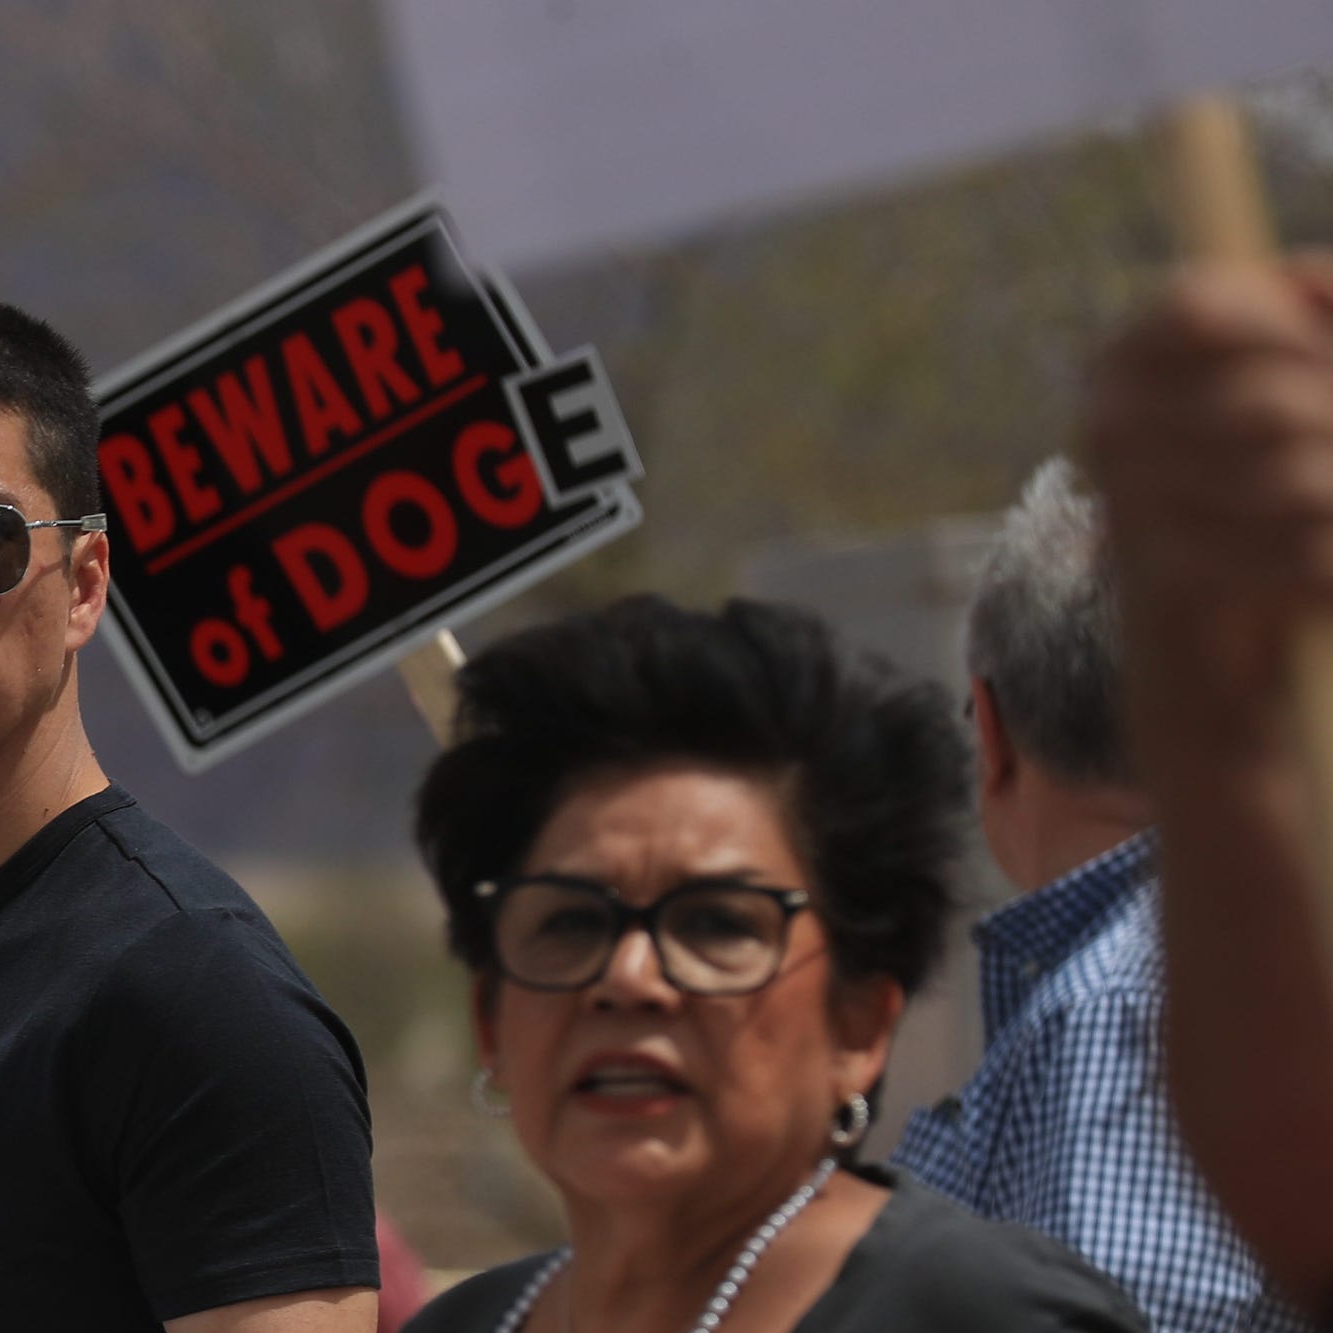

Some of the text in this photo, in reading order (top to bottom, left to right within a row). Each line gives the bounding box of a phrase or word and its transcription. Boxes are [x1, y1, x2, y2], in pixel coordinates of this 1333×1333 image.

[97, 264, 466, 555] BEWARE
[189, 357, 629, 688] of DOGE
